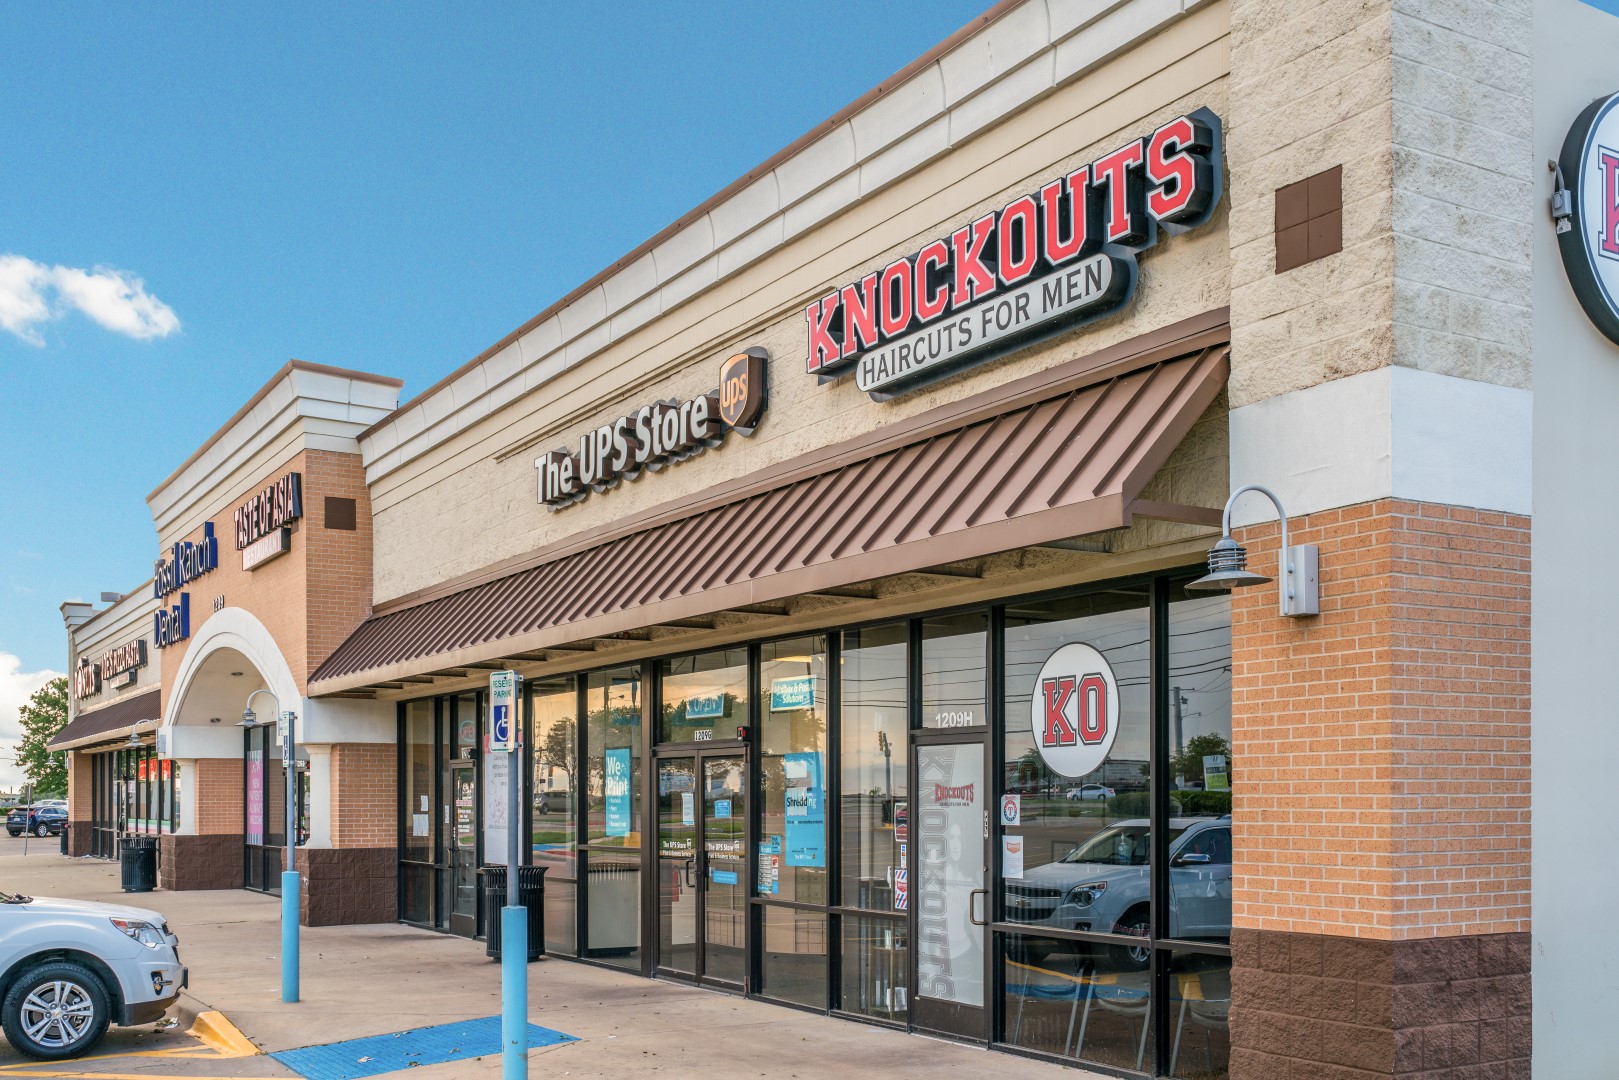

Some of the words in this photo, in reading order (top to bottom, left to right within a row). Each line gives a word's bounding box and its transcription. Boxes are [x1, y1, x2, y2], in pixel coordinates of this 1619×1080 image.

[806, 115, 1196, 374] KNOCKOUTS
[862, 317, 972, 387] HAIRCUTS
[980, 292, 1029, 338] FOR
[1042, 260, 1102, 313] MEN
[722, 373, 747, 415] ups
[534, 451, 573, 504] The
[580, 416, 628, 485] UPS
[635, 395, 709, 463] Store
[234, 496, 259, 550] TASTE
[260, 486, 271, 535] OF
[272, 472, 295, 528] ASIA
[154, 543, 177, 598] Fossil
[180, 521, 211, 584] Ranch
[154, 592, 183, 648] Dental
[935, 711, 973, 728] 1209H
[1042, 672, 1108, 748] KO
[786, 796, 817, 809] Shredding
[935, 783, 974, 803] KNOCKOUTS
[918, 747, 957, 1000] KNOCKOUTS
